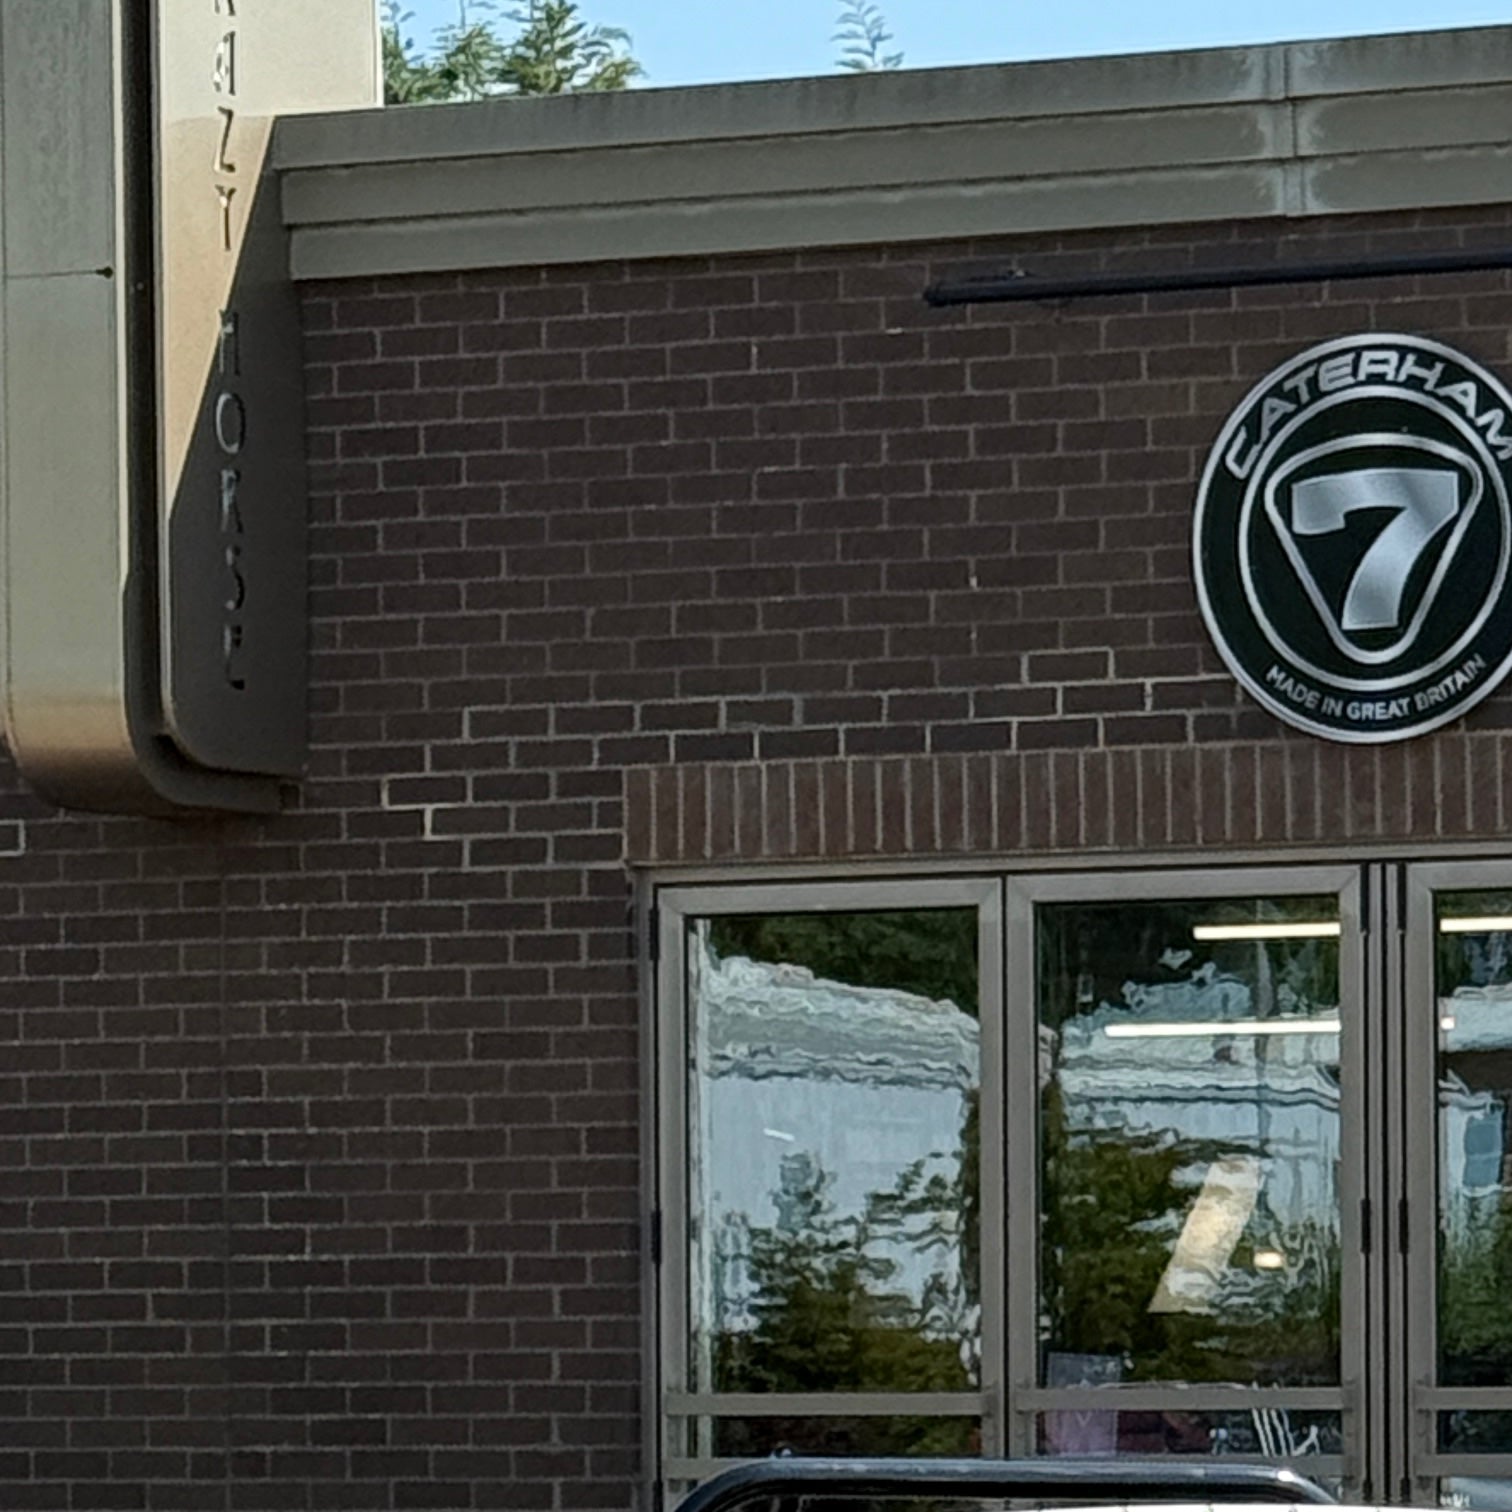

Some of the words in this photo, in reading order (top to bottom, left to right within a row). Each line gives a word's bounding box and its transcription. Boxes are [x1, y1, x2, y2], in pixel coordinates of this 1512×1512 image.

[213, 0, 237, 251] AZY
[1291, 467, 1459, 631] 7
[1265, 664, 1318, 709] MADE
[1321, 696, 1344, 718] IN
[1346, 697, 1412, 721] GREAT
[1415, 653, 1486, 711] BRITAIN
